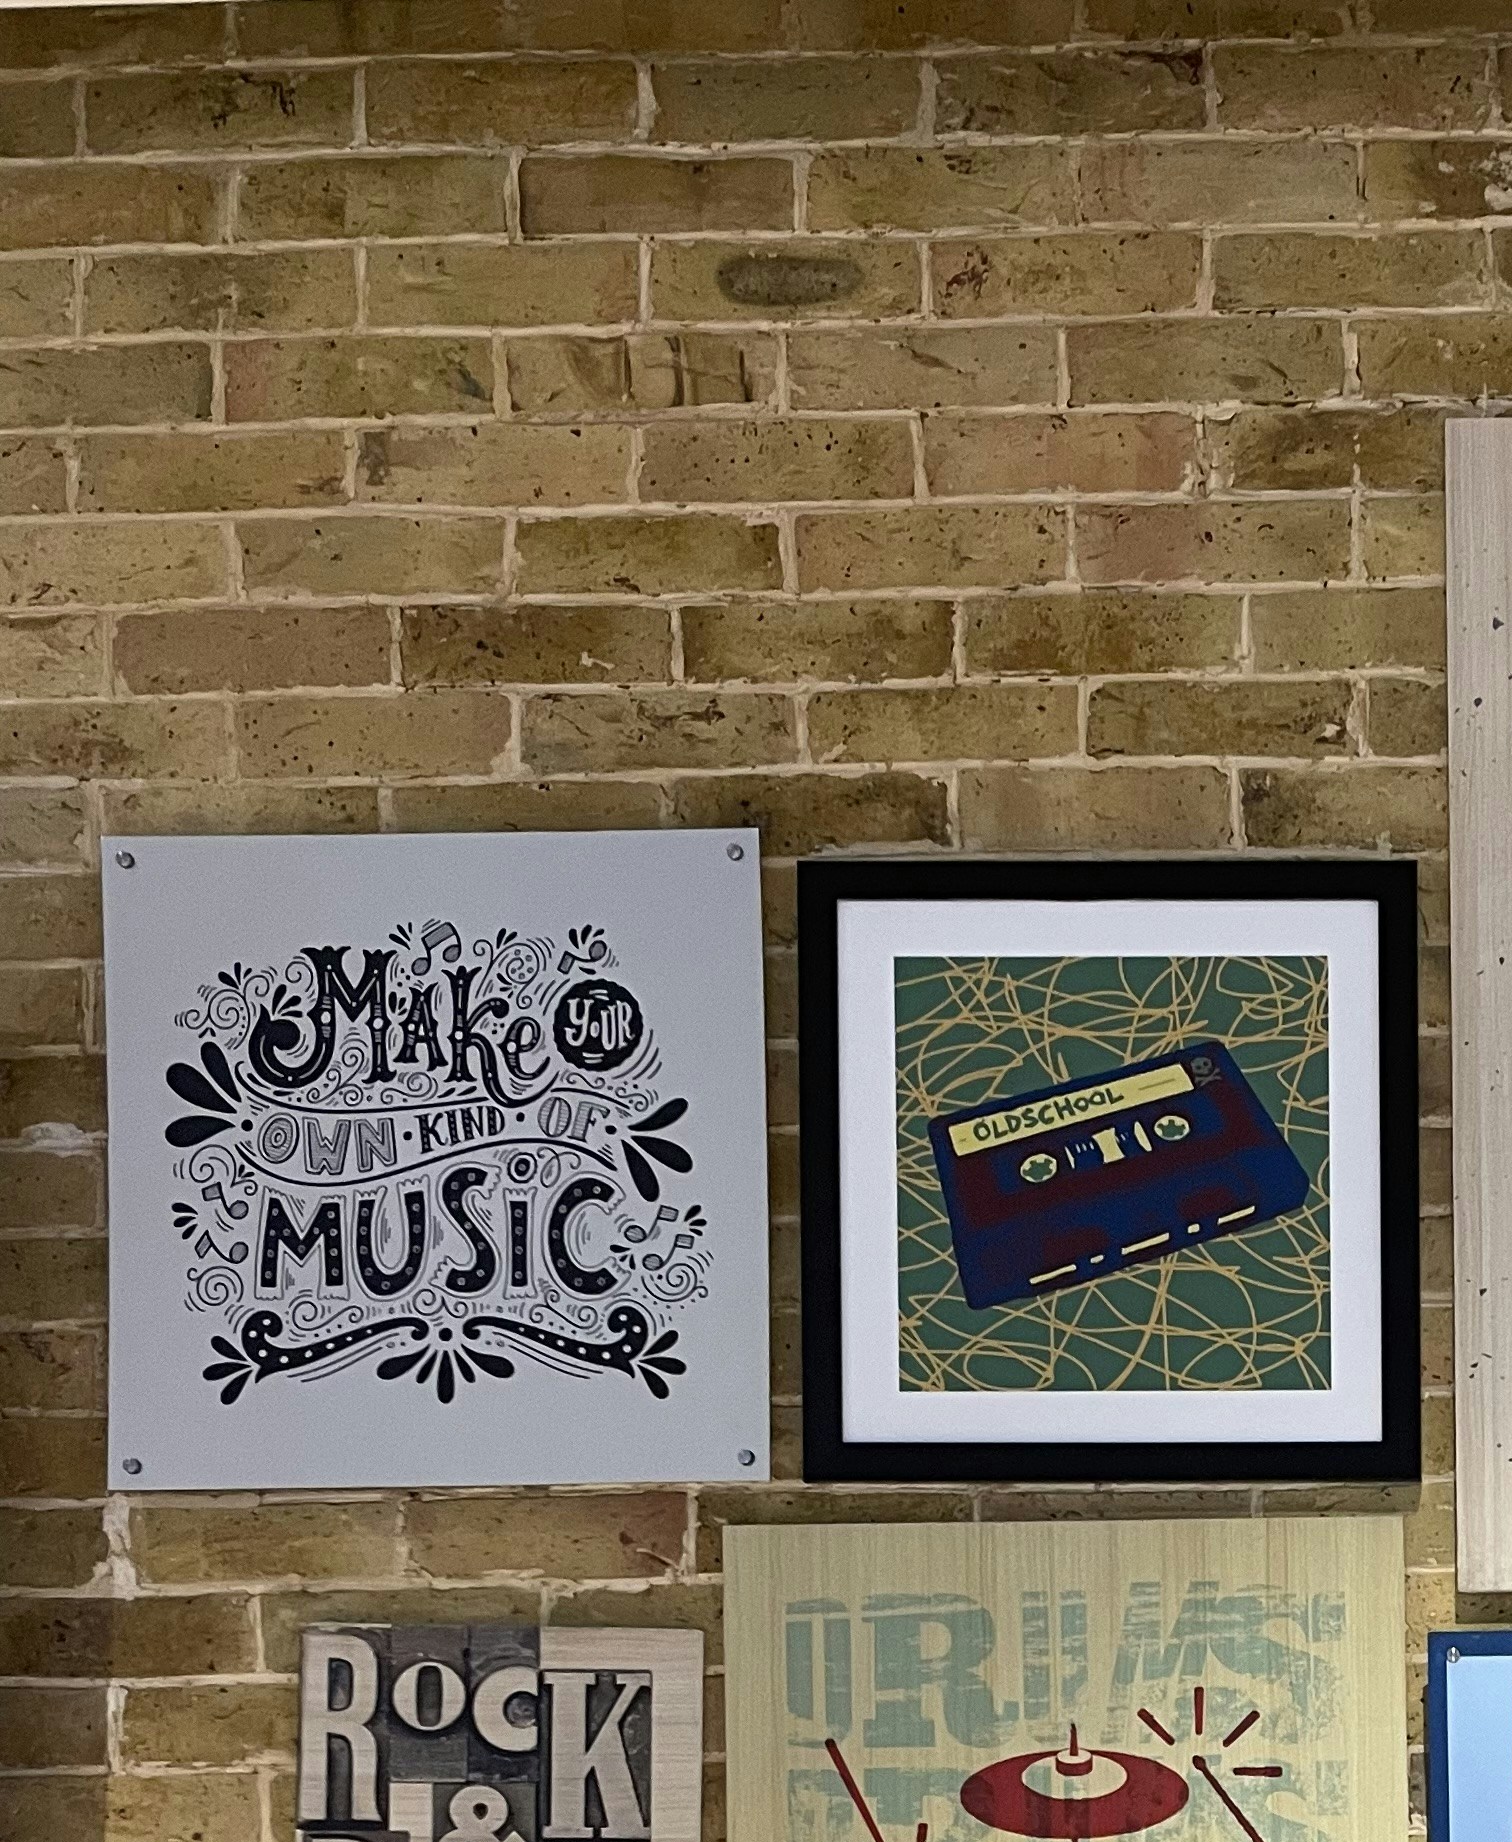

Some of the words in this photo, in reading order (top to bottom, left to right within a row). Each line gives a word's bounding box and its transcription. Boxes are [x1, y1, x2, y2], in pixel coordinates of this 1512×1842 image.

[257, 1111, 398, 1176] OWN
[413, 1105, 505, 1154] KIND
[537, 1096, 611, 1143] OF
[973, 1087, 1124, 1142] OLDSCHOOL
[254, 1164, 632, 1300] MUSIC
